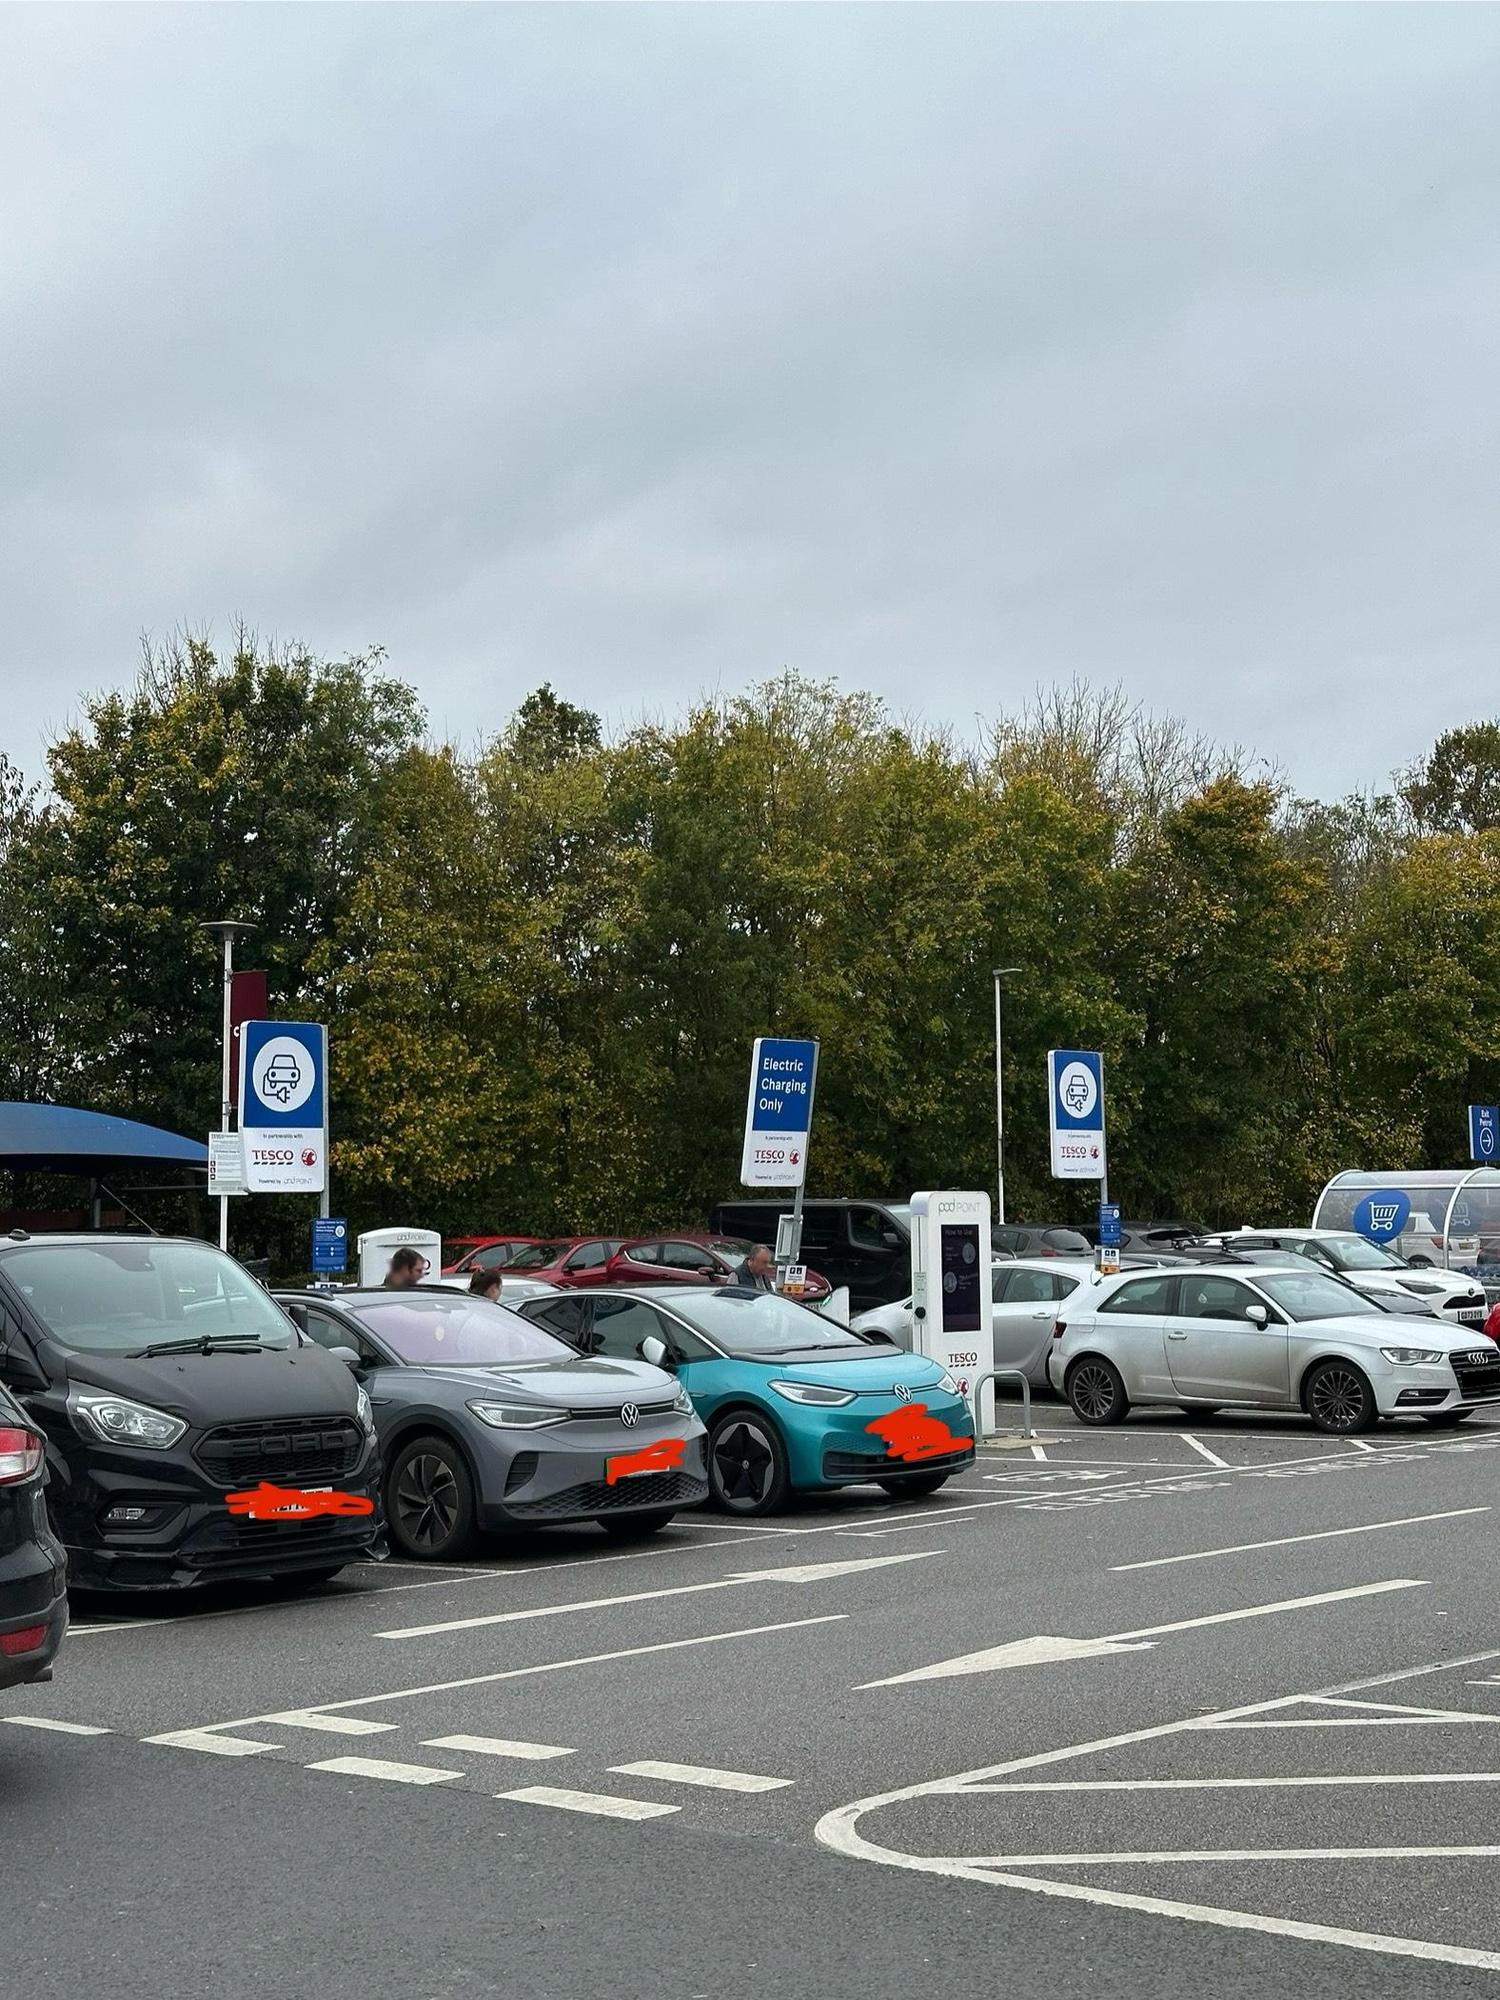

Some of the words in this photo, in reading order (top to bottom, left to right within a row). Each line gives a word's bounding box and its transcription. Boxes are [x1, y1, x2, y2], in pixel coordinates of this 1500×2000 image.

[763, 1058, 804, 1072] Electric
[761, 1078, 807, 1094] Charging
[759, 1098, 784, 1113] Only
[1481, 1109, 1490, 1118] Exit
[251, 1149, 294, 1161] TESCO
[754, 1149, 785, 1160] TESCO
[1060, 1146, 1086, 1155] TESCO
[947, 1352, 978, 1363] TESCO
[229, 1430, 345, 1459] FORD
